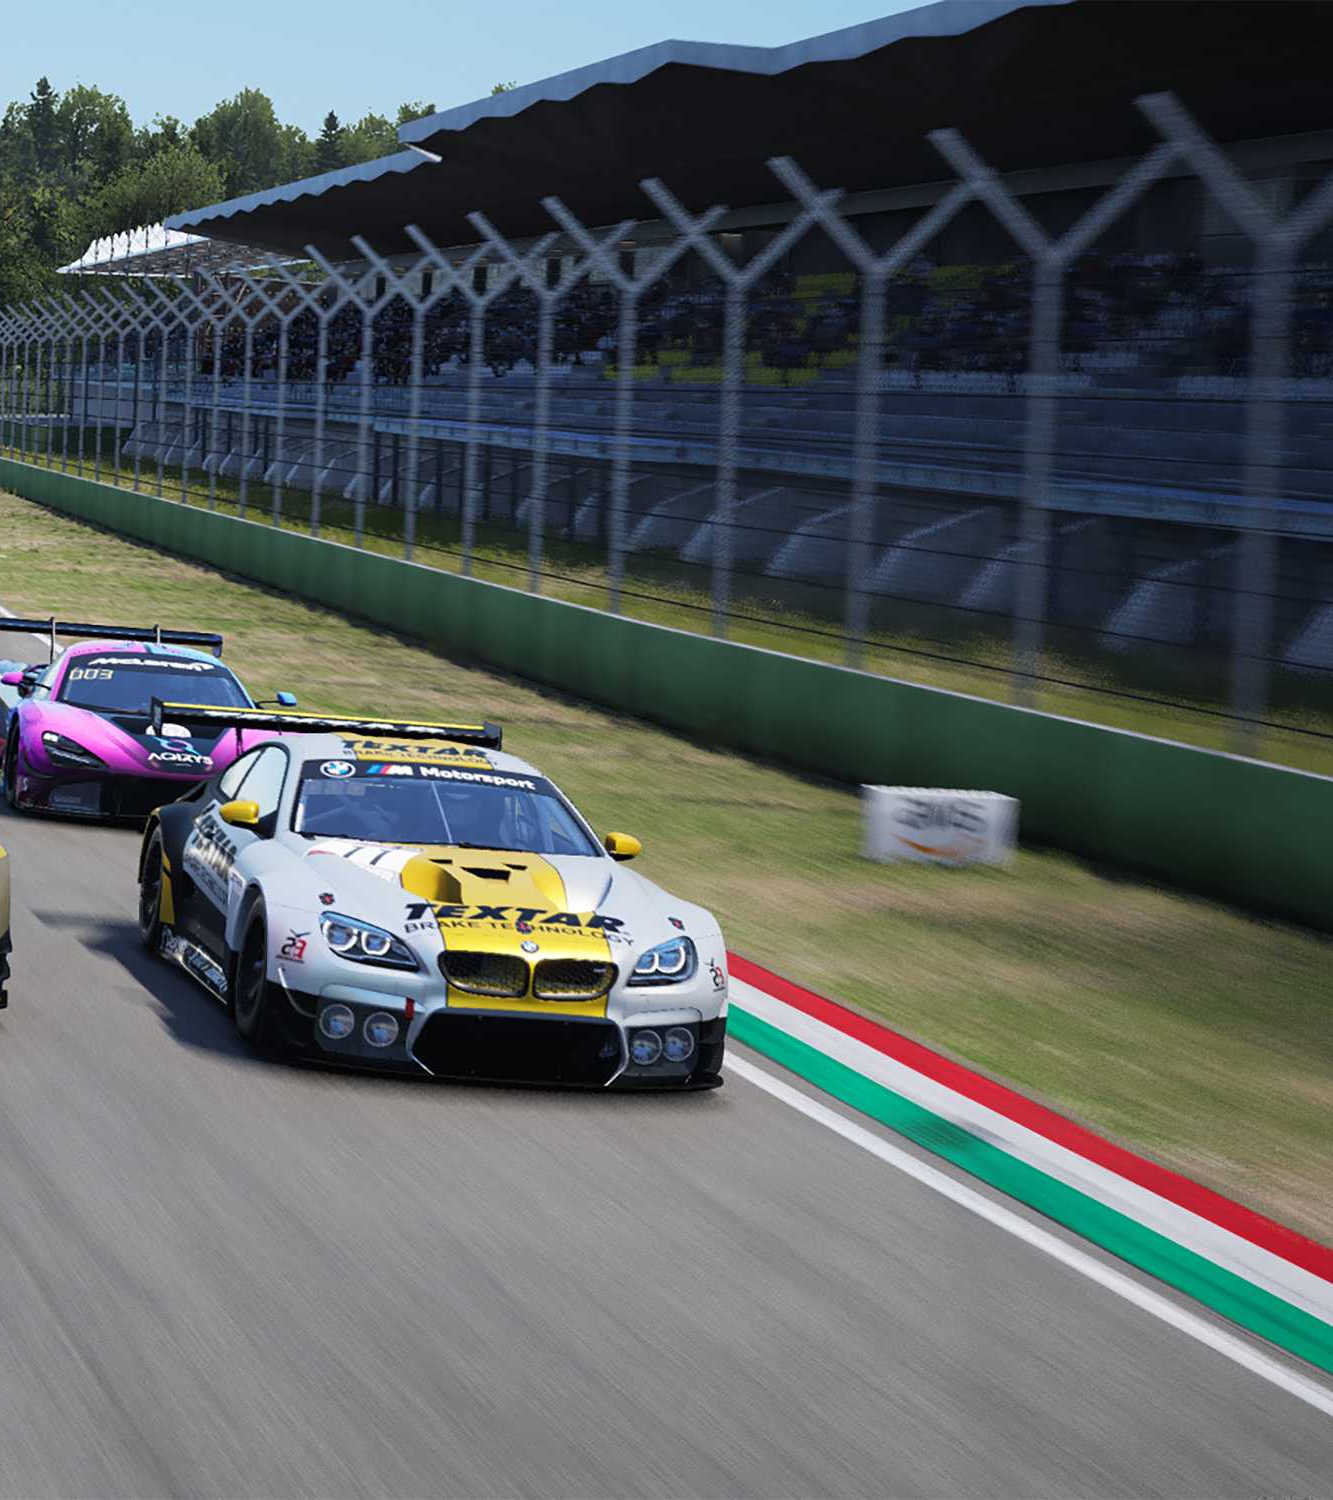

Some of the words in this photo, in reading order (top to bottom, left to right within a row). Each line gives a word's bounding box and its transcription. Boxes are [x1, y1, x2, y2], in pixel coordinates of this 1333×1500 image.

[342, 739, 488, 758] TEXTAR
[419, 765, 537, 791] Motorsport
[404, 902, 625, 934] TEXTAR
[404, 919, 485, 933] BRAKE
[489, 921, 634, 946] TEHNOLOGY
